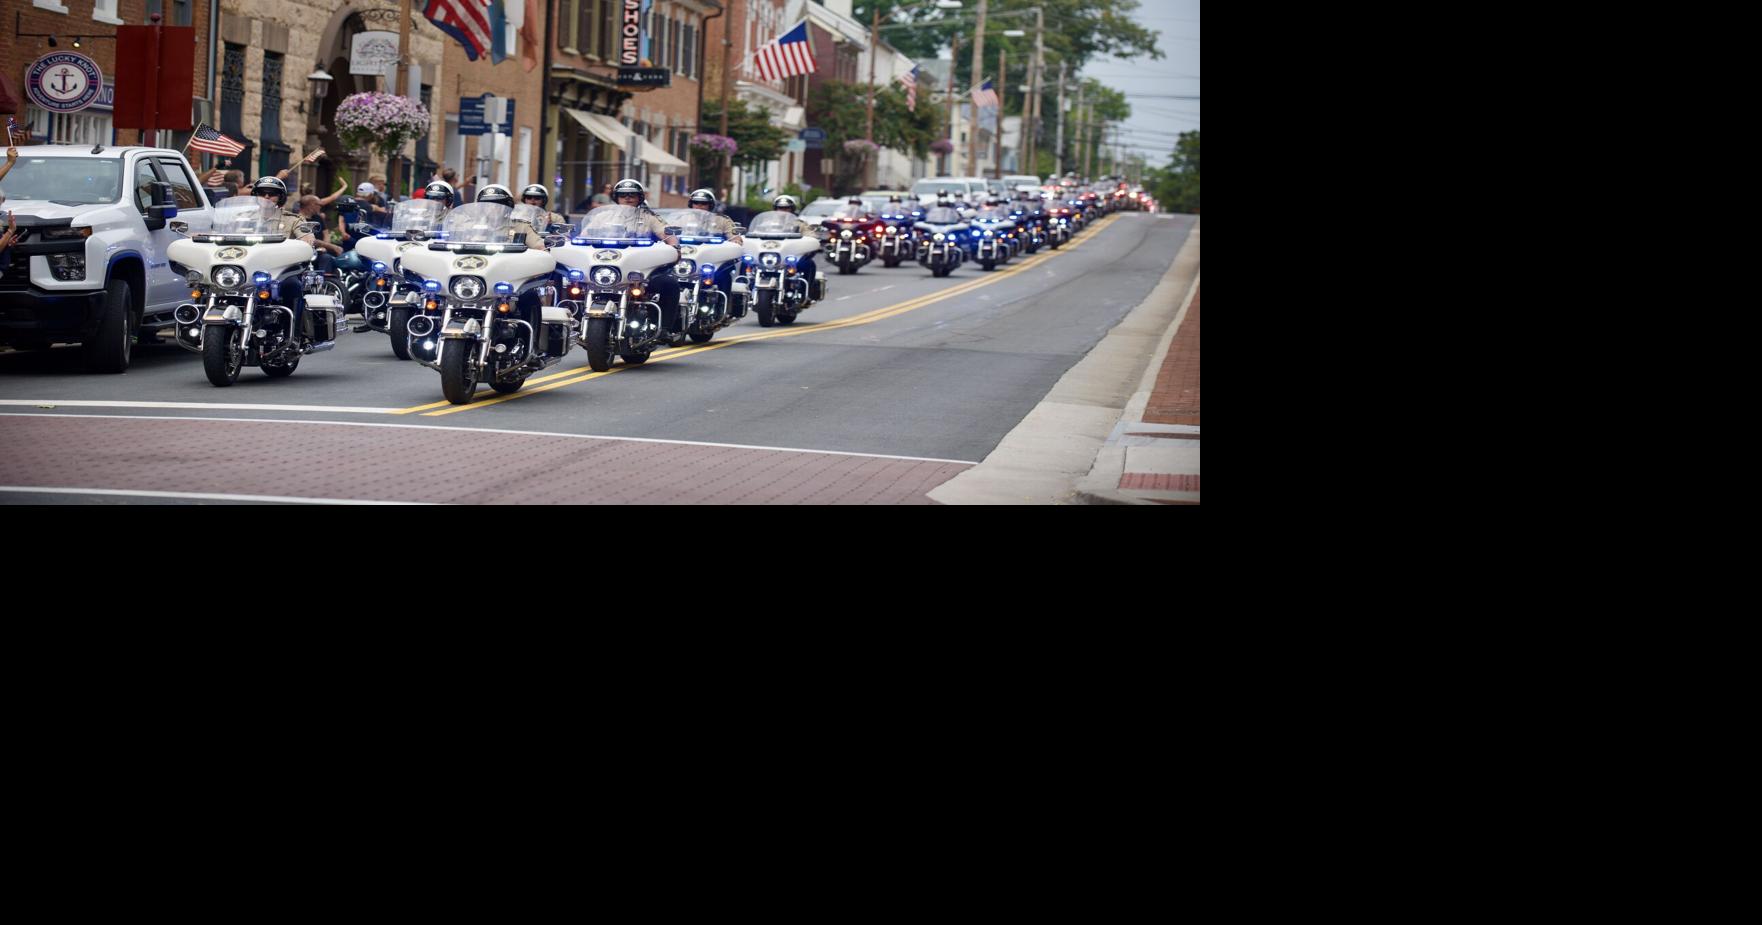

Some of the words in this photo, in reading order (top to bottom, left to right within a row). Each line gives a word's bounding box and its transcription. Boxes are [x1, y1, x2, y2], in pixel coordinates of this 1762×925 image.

[622, 0, 639, 65] SHOES
[33, 63, 47, 75] THE
[47, 56, 76, 64] LUCKY
